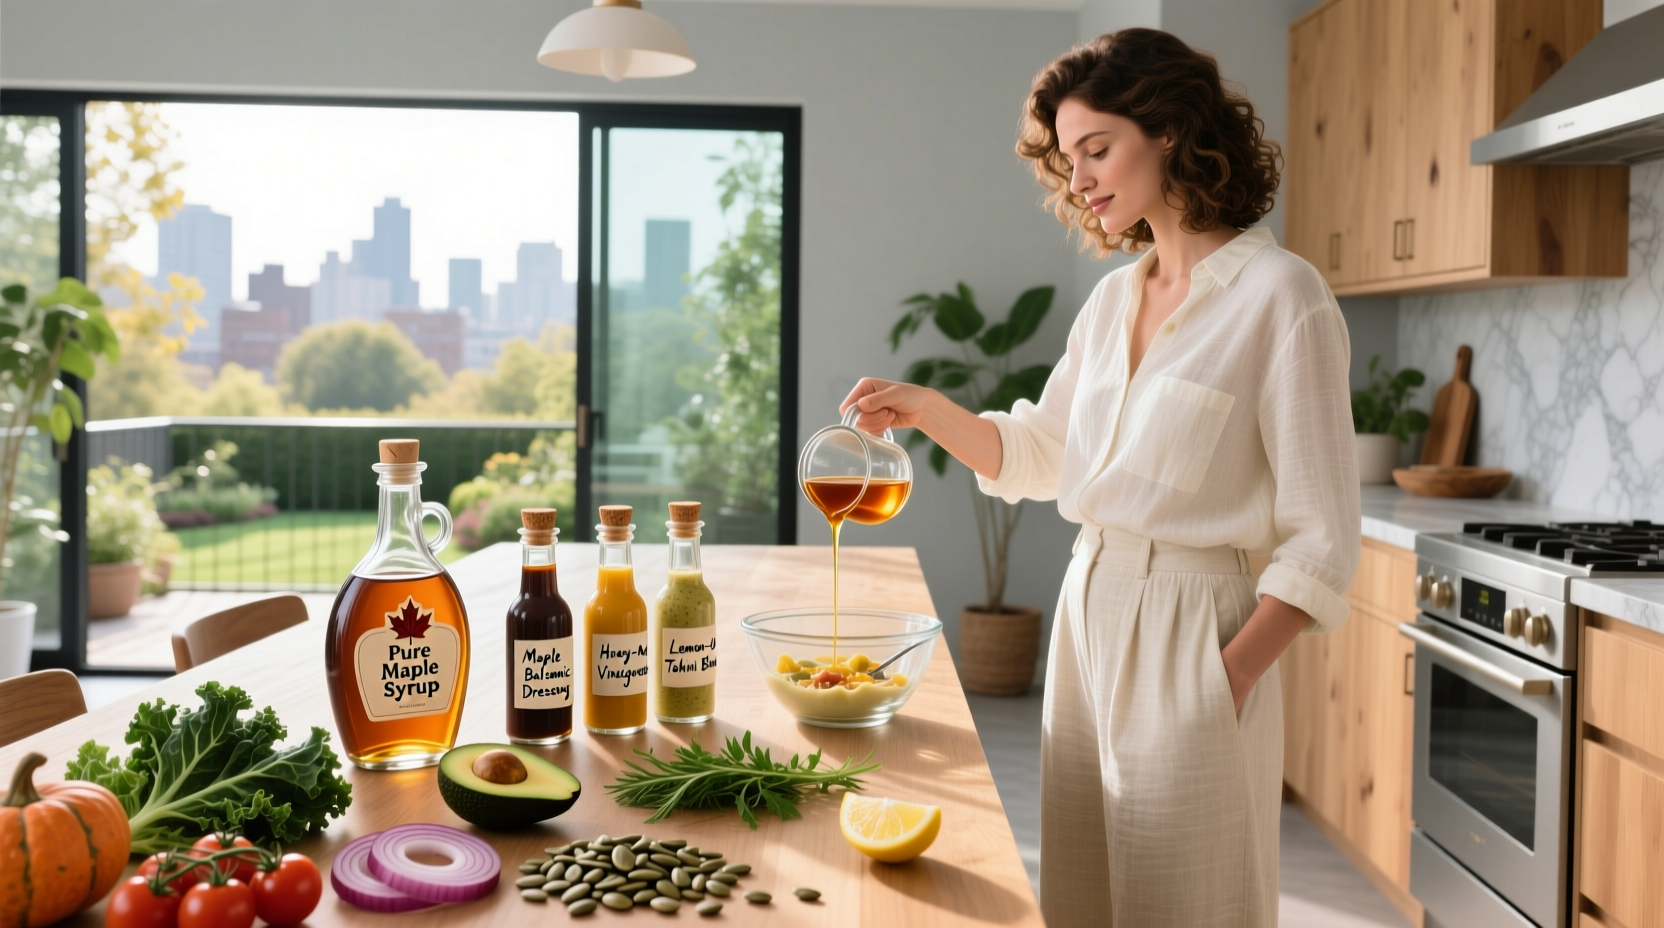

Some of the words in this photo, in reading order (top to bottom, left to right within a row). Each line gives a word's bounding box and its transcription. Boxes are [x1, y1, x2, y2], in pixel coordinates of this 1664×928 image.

[389, 645, 431, 661] Pure
[381, 659, 439, 681] Maple
[383, 681, 440, 702] Syrup
